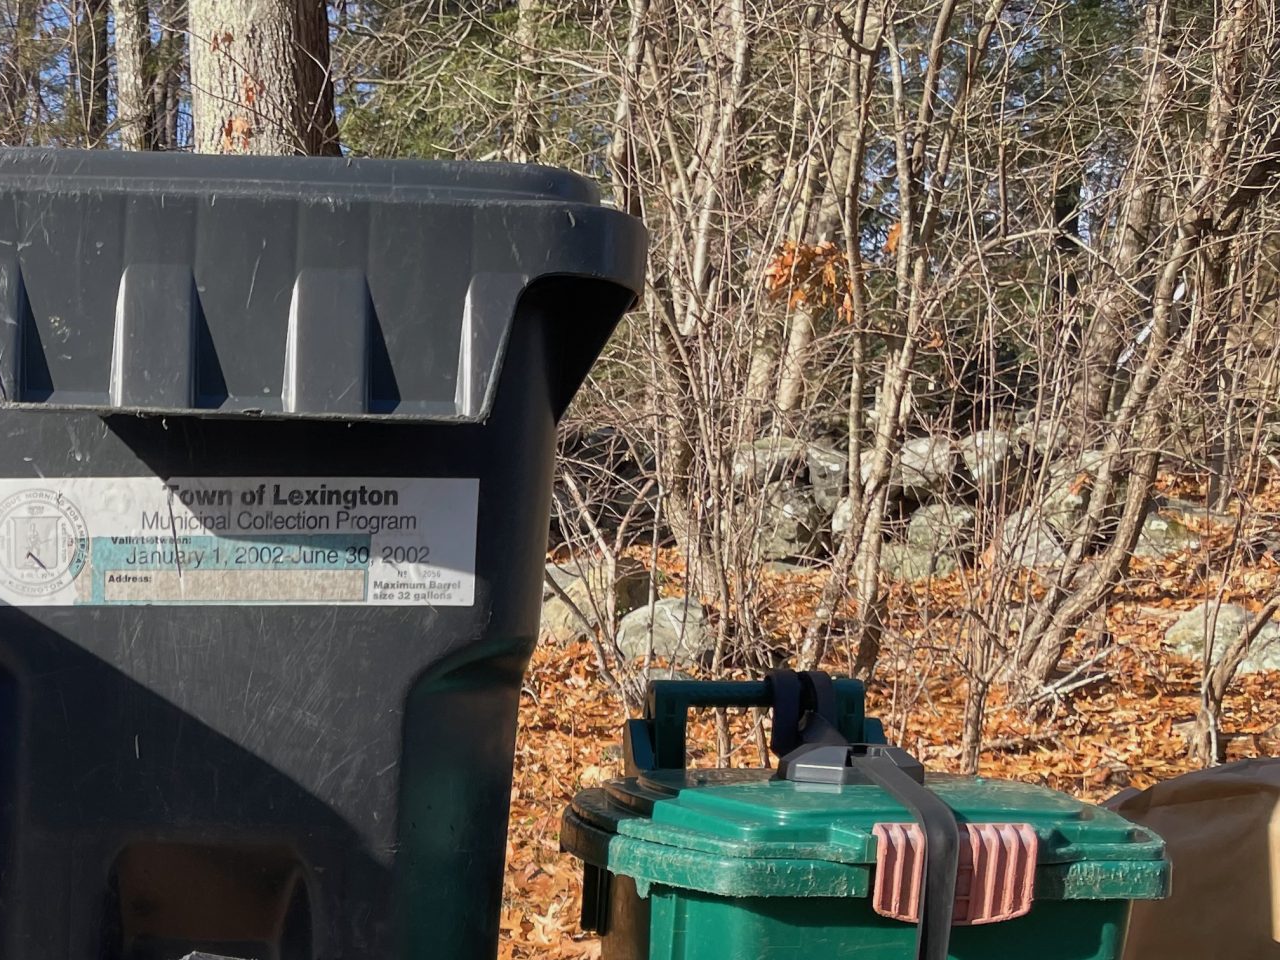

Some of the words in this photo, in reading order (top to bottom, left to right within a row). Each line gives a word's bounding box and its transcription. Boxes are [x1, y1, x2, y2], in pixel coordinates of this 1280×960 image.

[162, 483, 232, 506] Town
[241, 483, 266, 506] of
[273, 483, 399, 510] Lexington
[141, 511, 231, 535] Municipal
[237, 511, 330, 531] Collection
[336, 511, 418, 535] Program
[126, 546, 204, 569] January
[213, 546, 228, 567] 1,
[345, 545, 375, 567] 30,
[382, 545, 431, 565] 2002
[108, 574, 152, 584] Address:
[373, 580, 426, 590] Maximum
[429, 580, 461, 590] Barrel
[373, 591, 395, 600] size
[398, 591, 411, 600] 32
[413, 591, 453, 602] gallons
